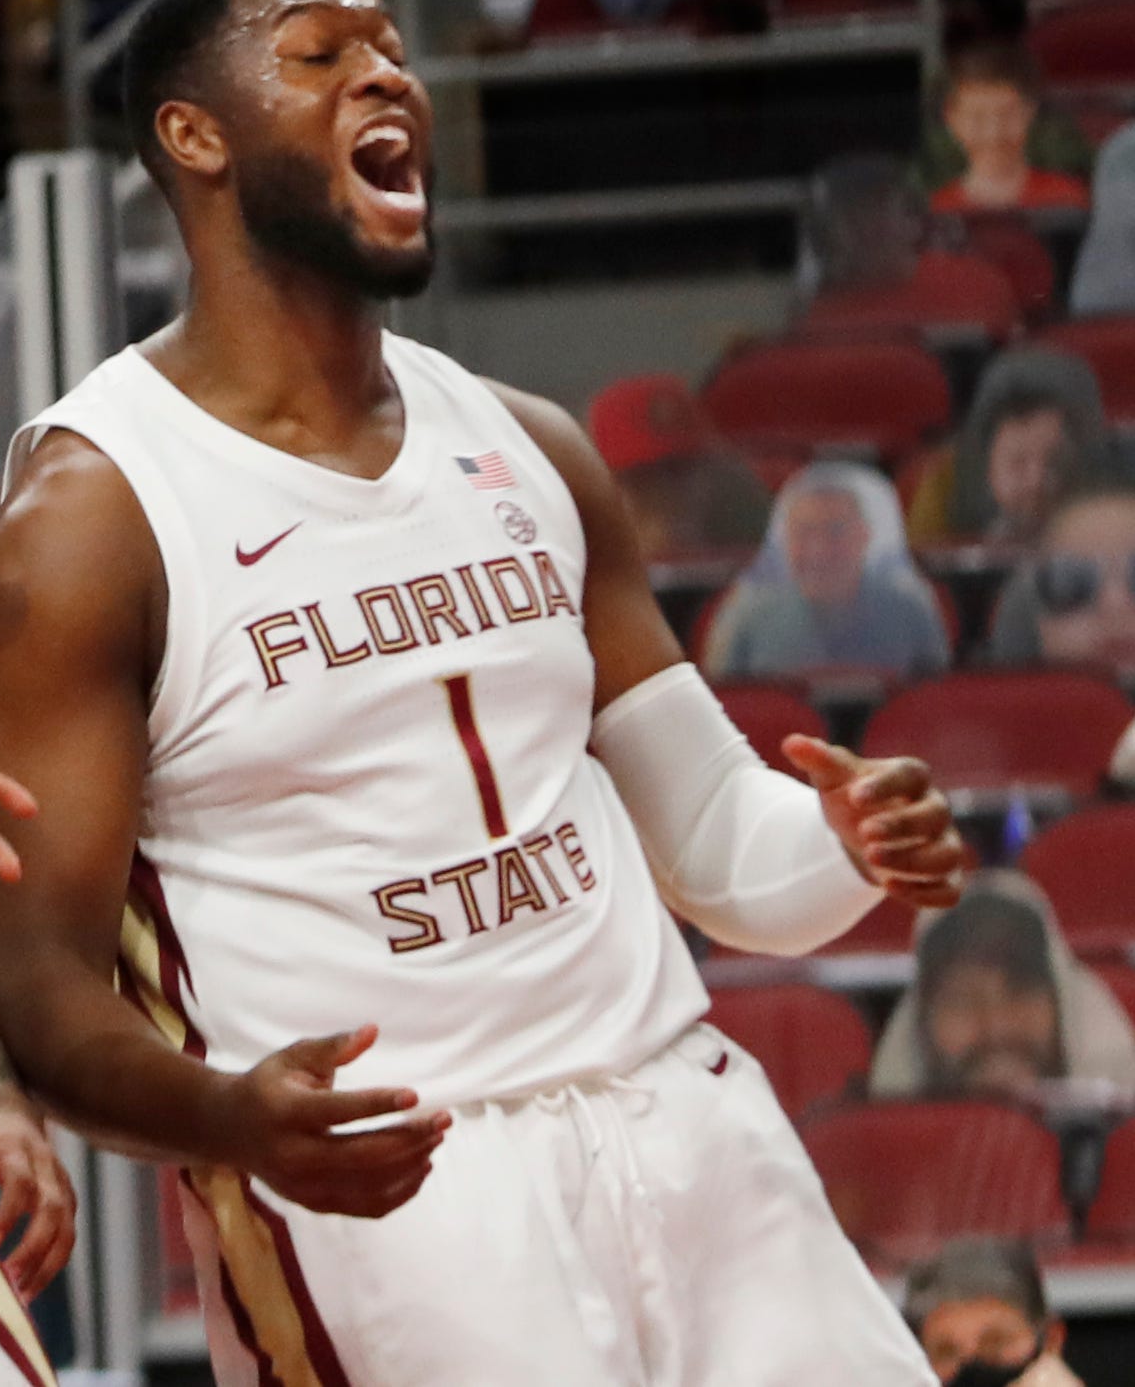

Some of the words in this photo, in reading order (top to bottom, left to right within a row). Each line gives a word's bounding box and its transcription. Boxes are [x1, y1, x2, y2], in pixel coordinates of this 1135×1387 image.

[244, 551, 578, 691] FLORIDA
[434, 671, 510, 843] 1
[371, 821, 597, 954] STATE
